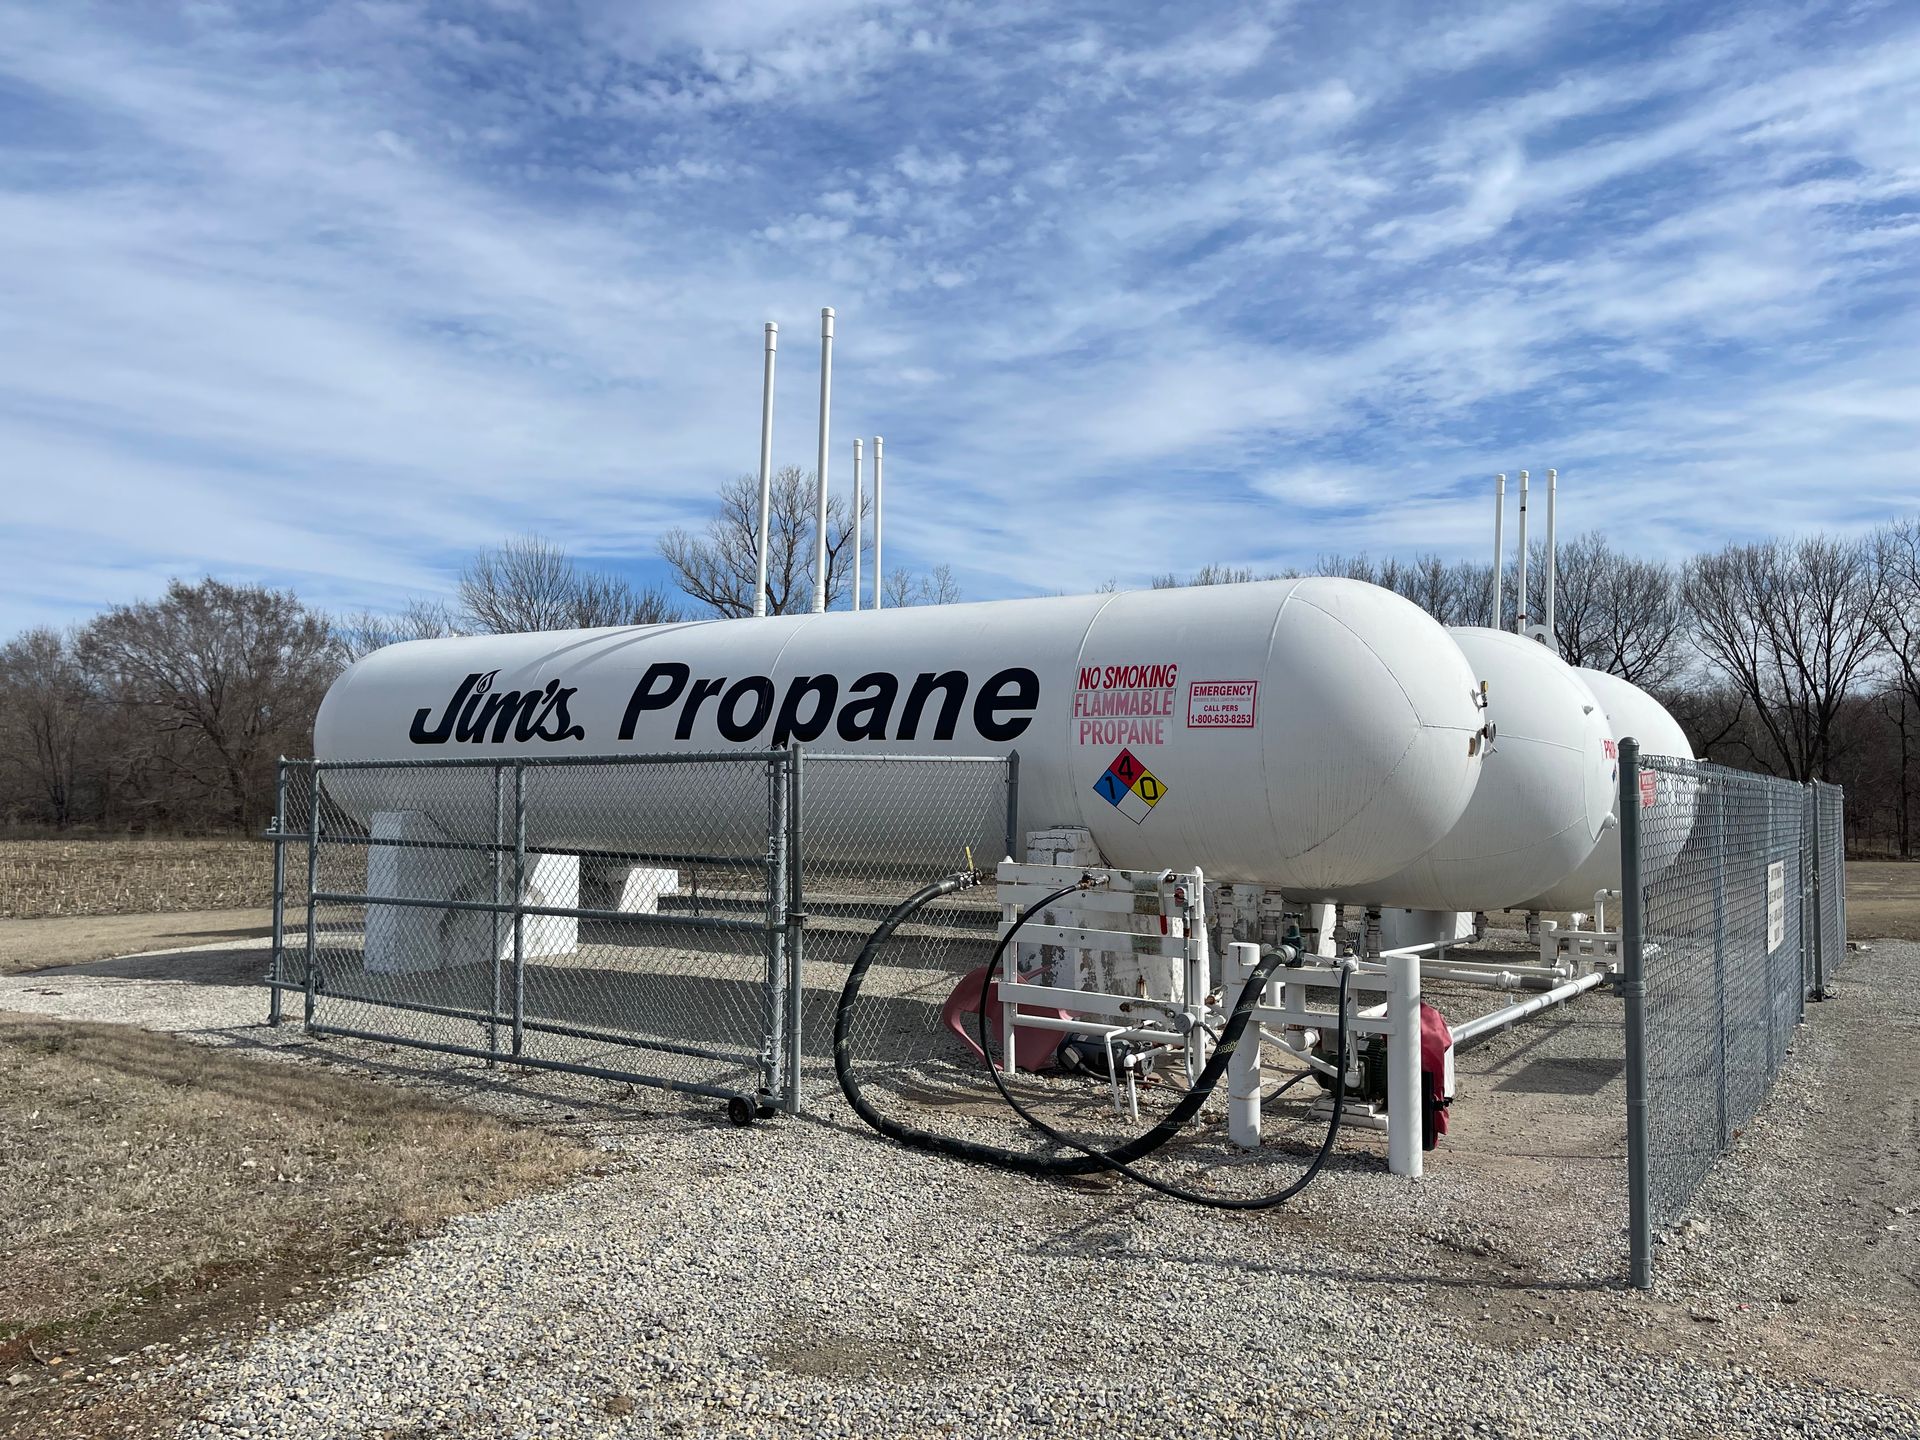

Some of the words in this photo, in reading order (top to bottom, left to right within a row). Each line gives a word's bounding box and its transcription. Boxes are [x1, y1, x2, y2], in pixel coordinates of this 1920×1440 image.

[1078, 666, 1101, 690] NO
[1103, 664, 1177, 689] SMOKING
[1193, 685, 1253, 696] EMERGENCY
[617, 661, 1040, 751] Propane
[1074, 691, 1173, 717] FLAMMABLE
[1221, 704, 1239, 712] PERS
[1191, 714, 1251, 724] 1-800-633-8253
[1080, 719, 1164, 745] PROPANE
[1117, 755, 1134, 780] 4
[1105, 776, 1116, 800] 1
[1139, 776, 1159, 800] 0
